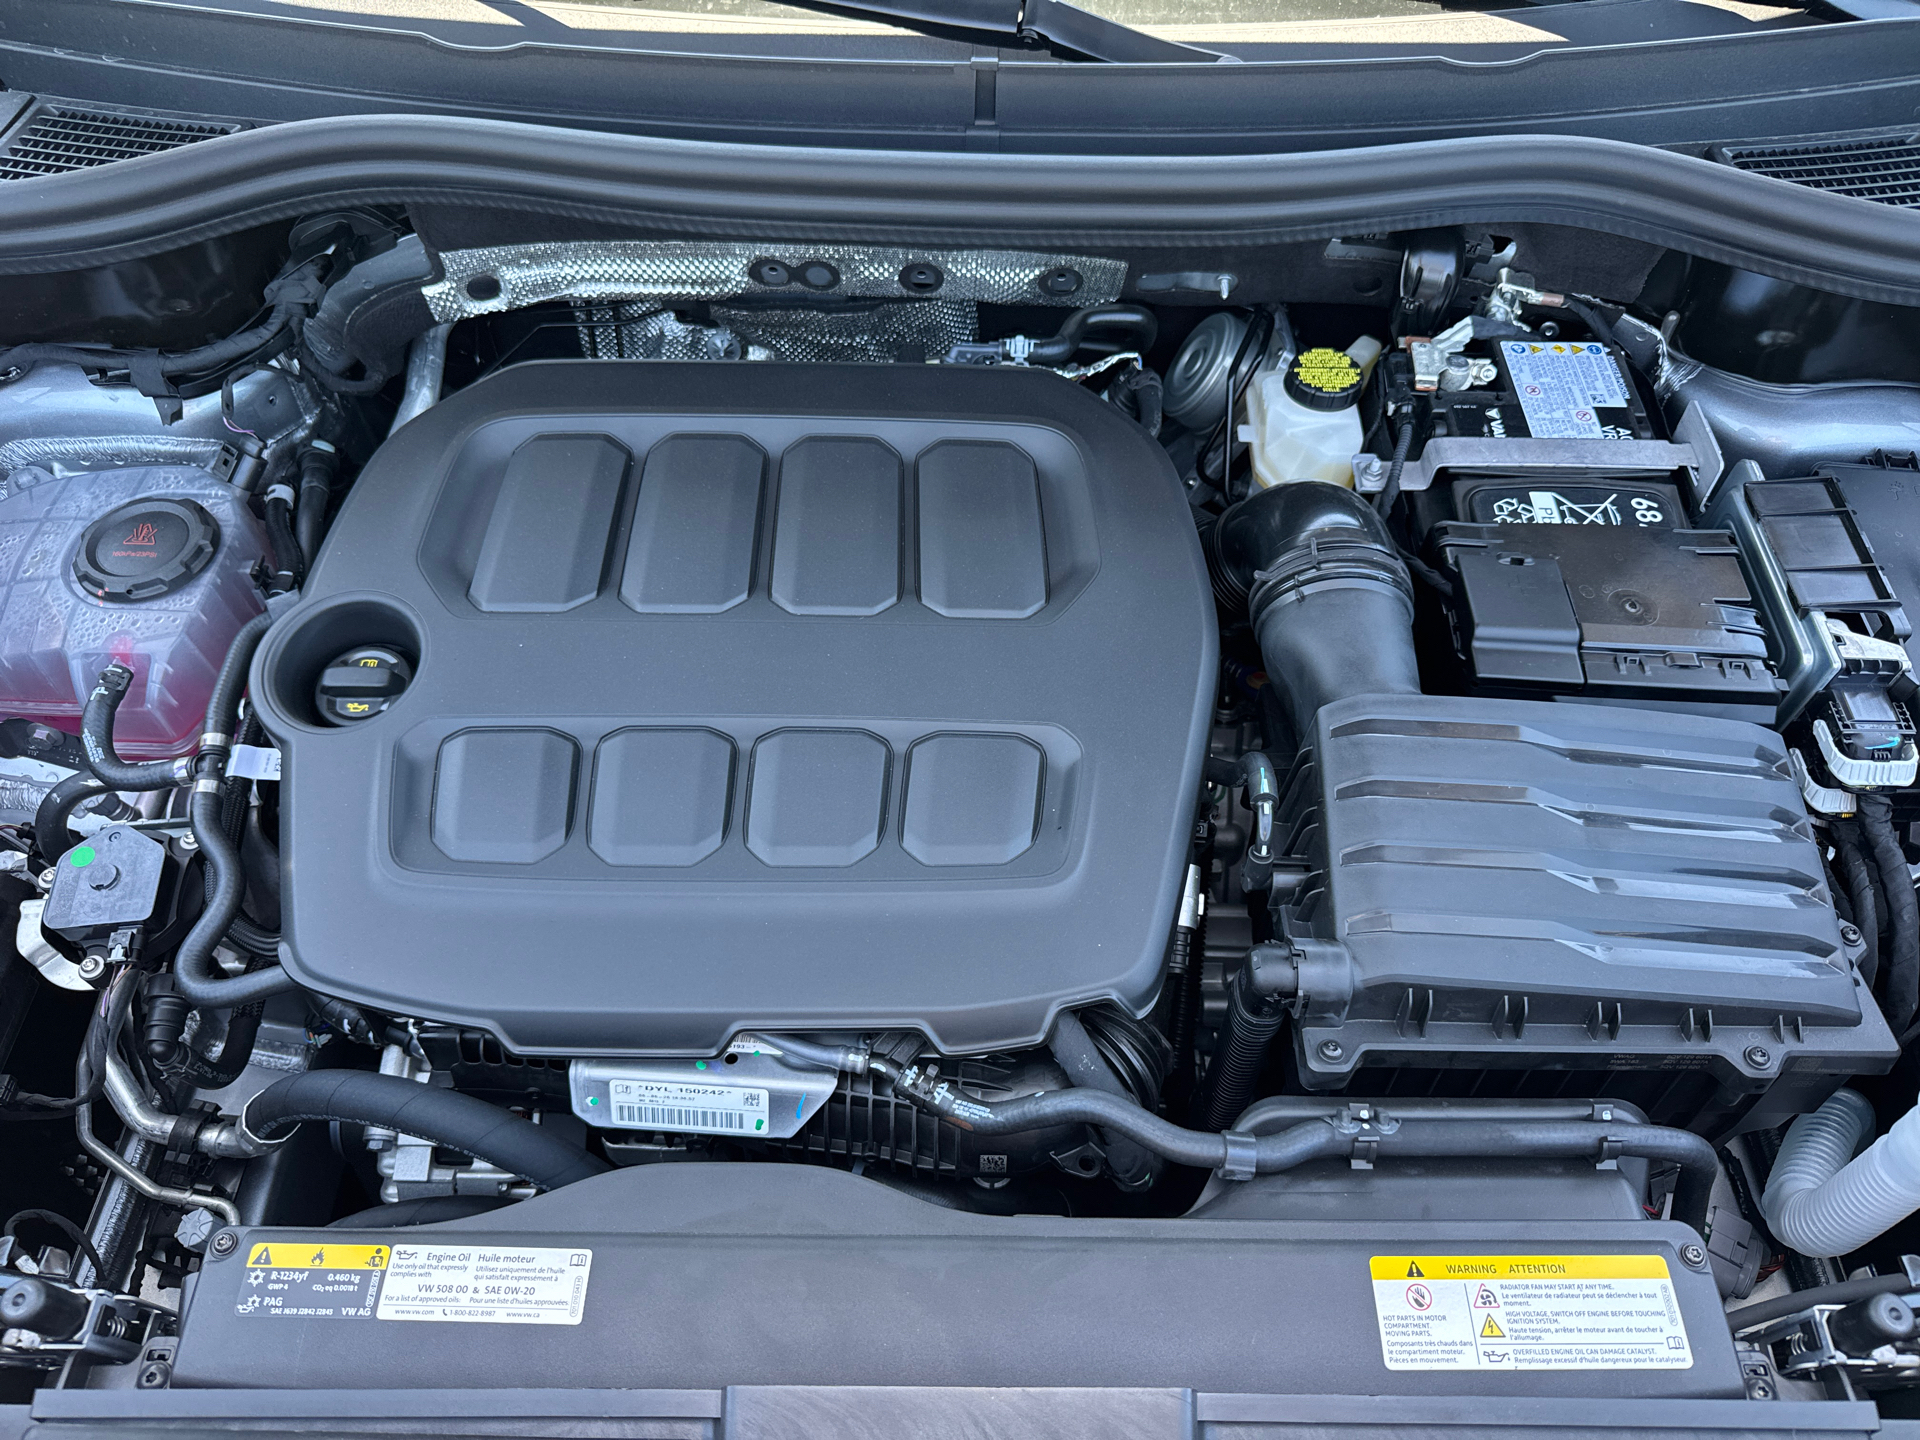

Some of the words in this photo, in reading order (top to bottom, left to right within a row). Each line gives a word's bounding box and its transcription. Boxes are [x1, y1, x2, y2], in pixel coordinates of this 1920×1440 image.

[426, 1253, 456, 1263] Engine
[458, 1253, 471, 1261] Oil
[478, 1254, 501, 1262] Huile
[503, 1255, 536, 1263] moteur
[1446, 1264, 1497, 1274] WARNING
[1509, 1264, 1566, 1274] ATTENTION
[270, 1271, 309, 1282] R-1234yf
[327, 1274, 349, 1282] 0.460
[350, 1274, 360, 1283] kg
[418, 1284, 435, 1292] VW
[436, 1285, 453, 1293] 508
[456, 1285, 468, 1293] 00
[484, 1286, 502, 1294] SAE
[504, 1286, 535, 1295] 0W-20
[263, 1297, 283, 1306] PAG
[342, 1308, 357, 1316] VW
[358, 1308, 371, 1316] AG
